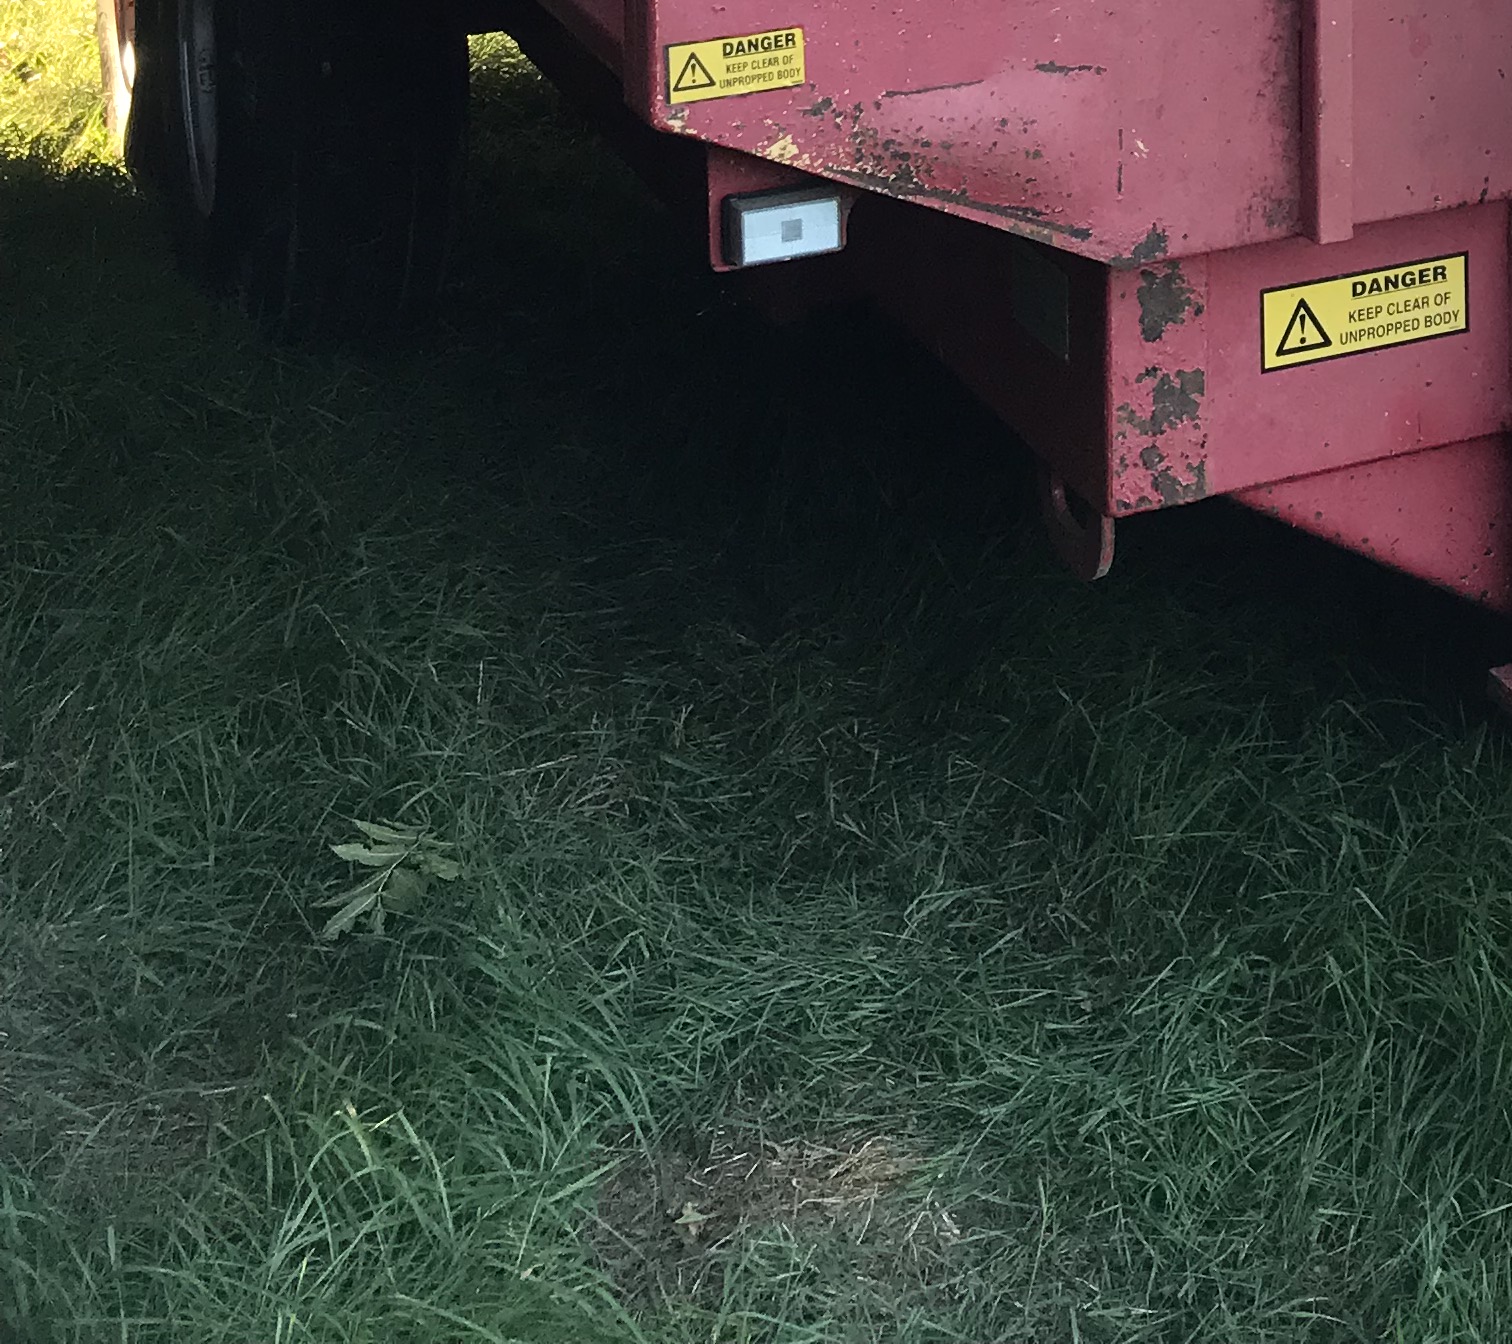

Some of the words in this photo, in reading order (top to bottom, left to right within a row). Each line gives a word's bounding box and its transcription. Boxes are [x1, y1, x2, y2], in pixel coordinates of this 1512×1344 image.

[722, 32, 796, 57] DANGER
[719, 72, 775, 89] UNPROPPED
[777, 67, 801, 81] BODY
[726, 61, 749, 74] KEEP
[751, 56, 780, 71] CLEAR
[783, 54, 794, 65] OF
[1351, 265, 1447, 298] DANGER
[1348, 305, 1383, 323] KEEP
[1386, 295, 1430, 316] CLEAR
[1434, 291, 1452, 307] OF
[1339, 317, 1420, 346] UNPROPPED
[1424, 309, 1461, 329] BODY
